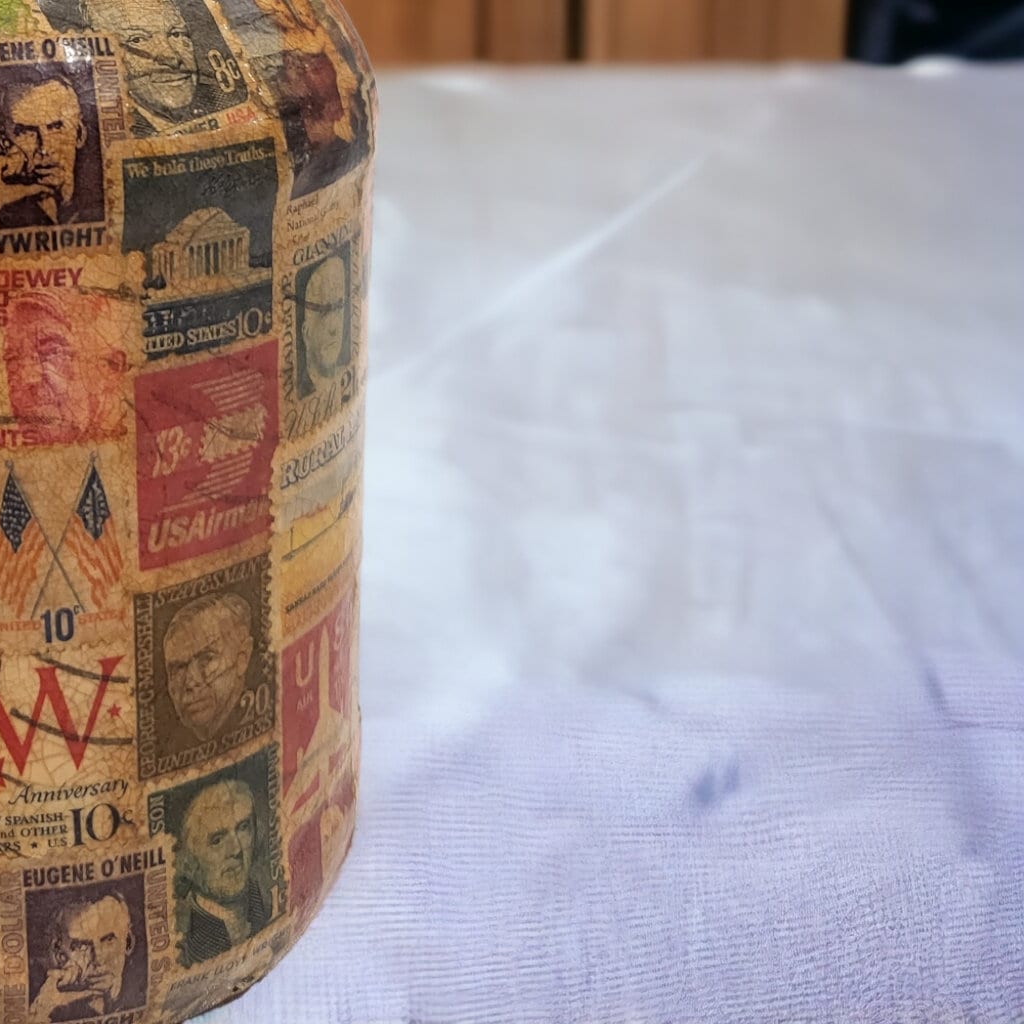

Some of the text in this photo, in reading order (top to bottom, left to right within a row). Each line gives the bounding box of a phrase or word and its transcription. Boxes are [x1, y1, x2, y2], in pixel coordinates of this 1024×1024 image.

[186, 319, 237, 346] STATES
[154, 556, 259, 610] STATESMAN
[157, 716, 273, 775] UNITED STATES
[8, 778, 130, 806] Anniversary
[20, 823, 69, 839] OTHER
[22, 846, 166, 888] EUGENE O'NEILL
[0, 871, 25, 976] DOLLAR
[145, 867, 171, 952] UNITED
